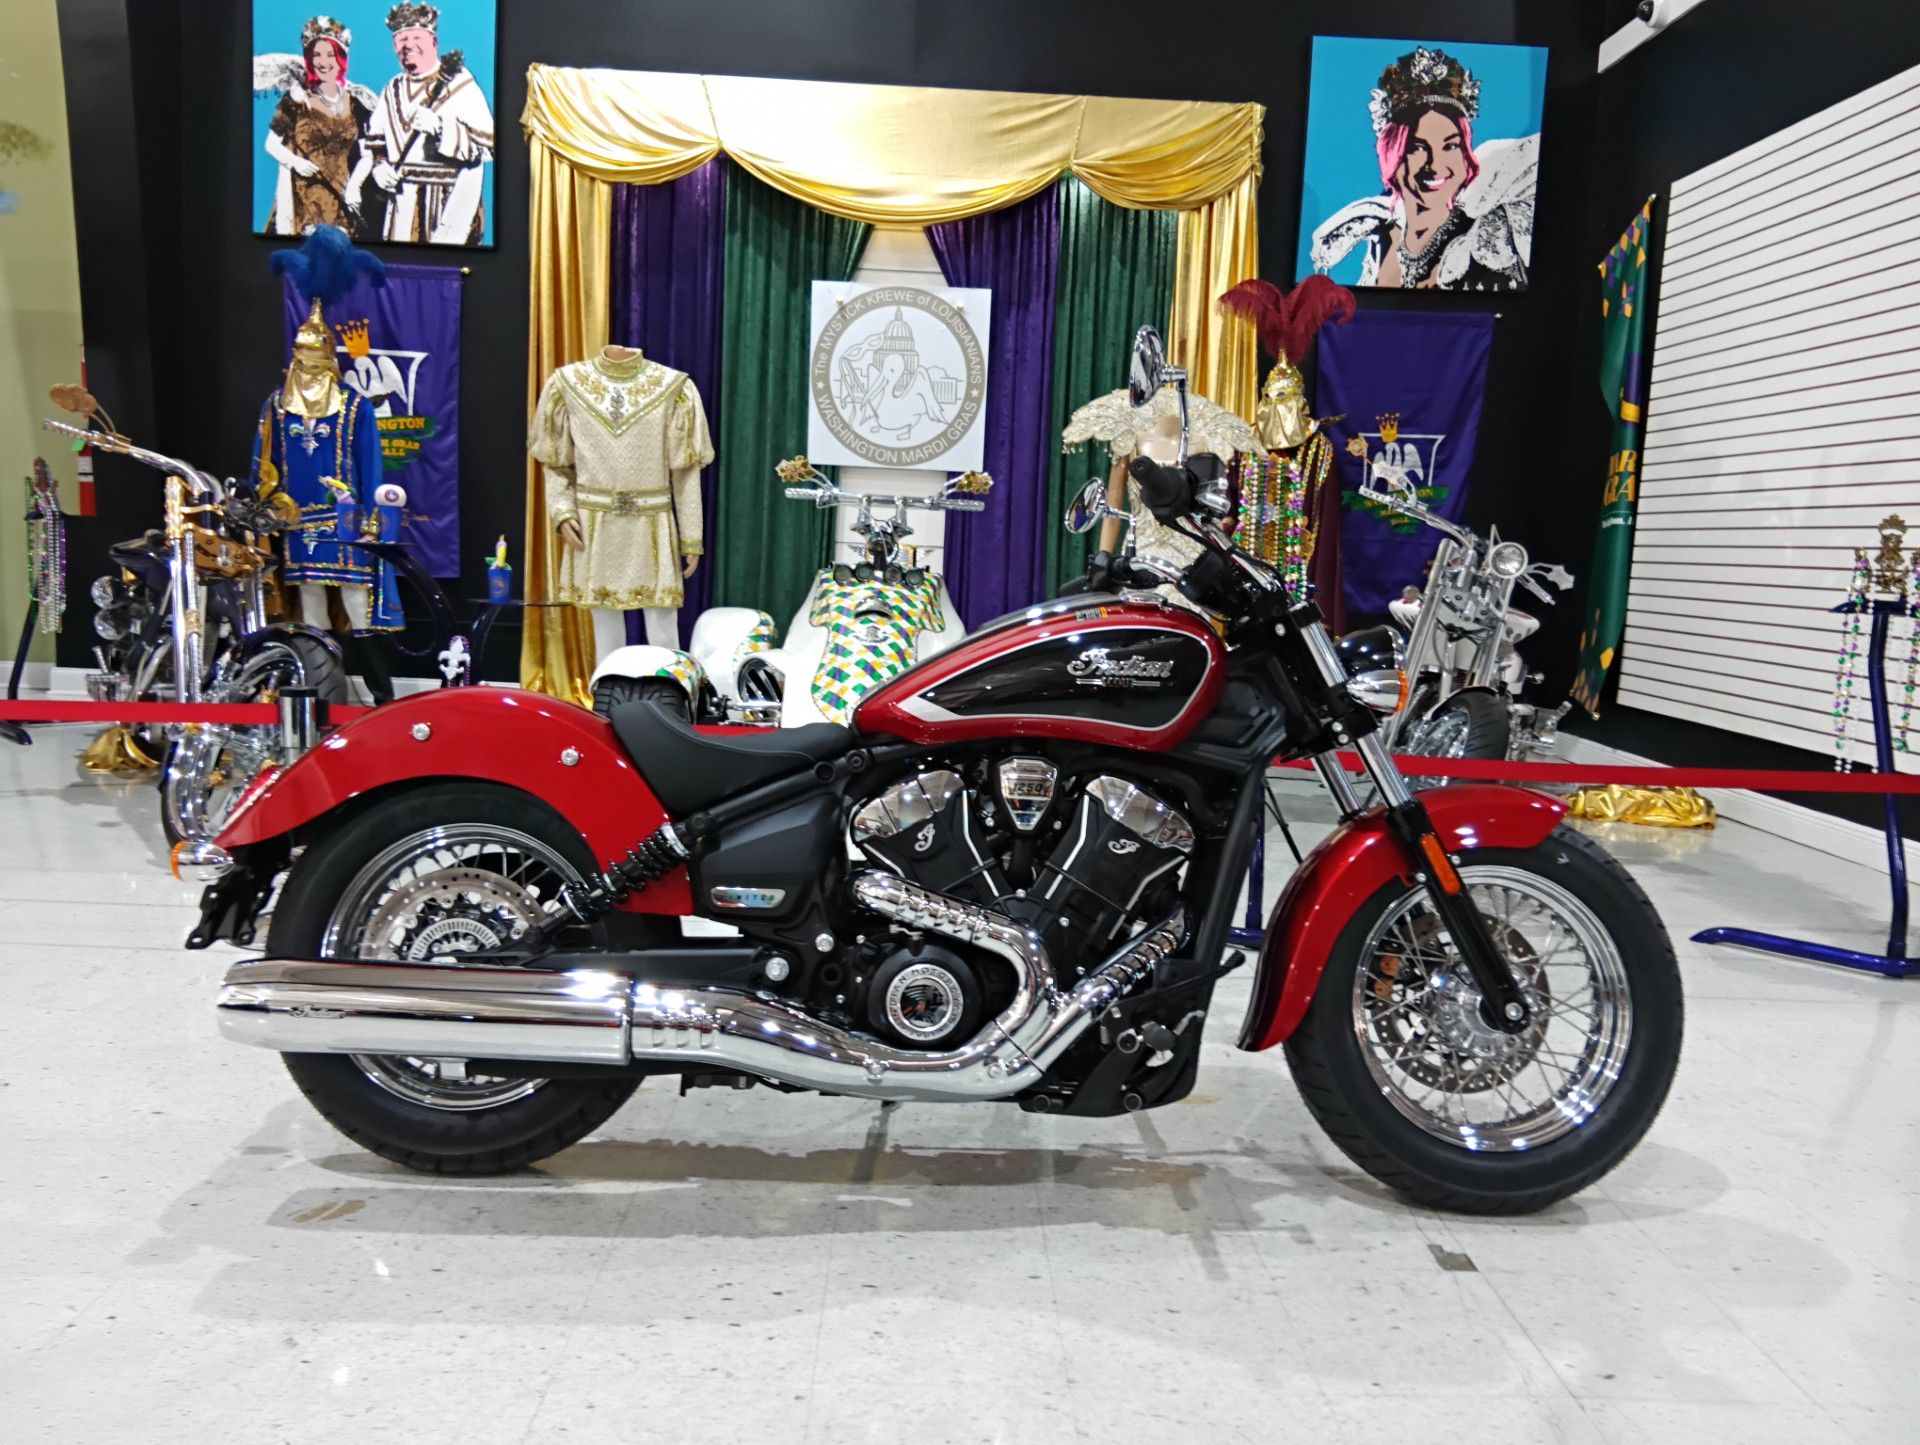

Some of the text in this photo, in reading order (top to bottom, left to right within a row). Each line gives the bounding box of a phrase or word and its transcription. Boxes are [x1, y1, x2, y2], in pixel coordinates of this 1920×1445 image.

[815, 290, 982, 385] The MYSTICK KREWE of LOUISIANIANS
[376, 416, 425, 430] NGTON
[817, 394, 977, 464] WASHINGTON MARDI GRAS
[382, 447, 407, 456] ALL
[1066, 648, 1175, 678] Indian
